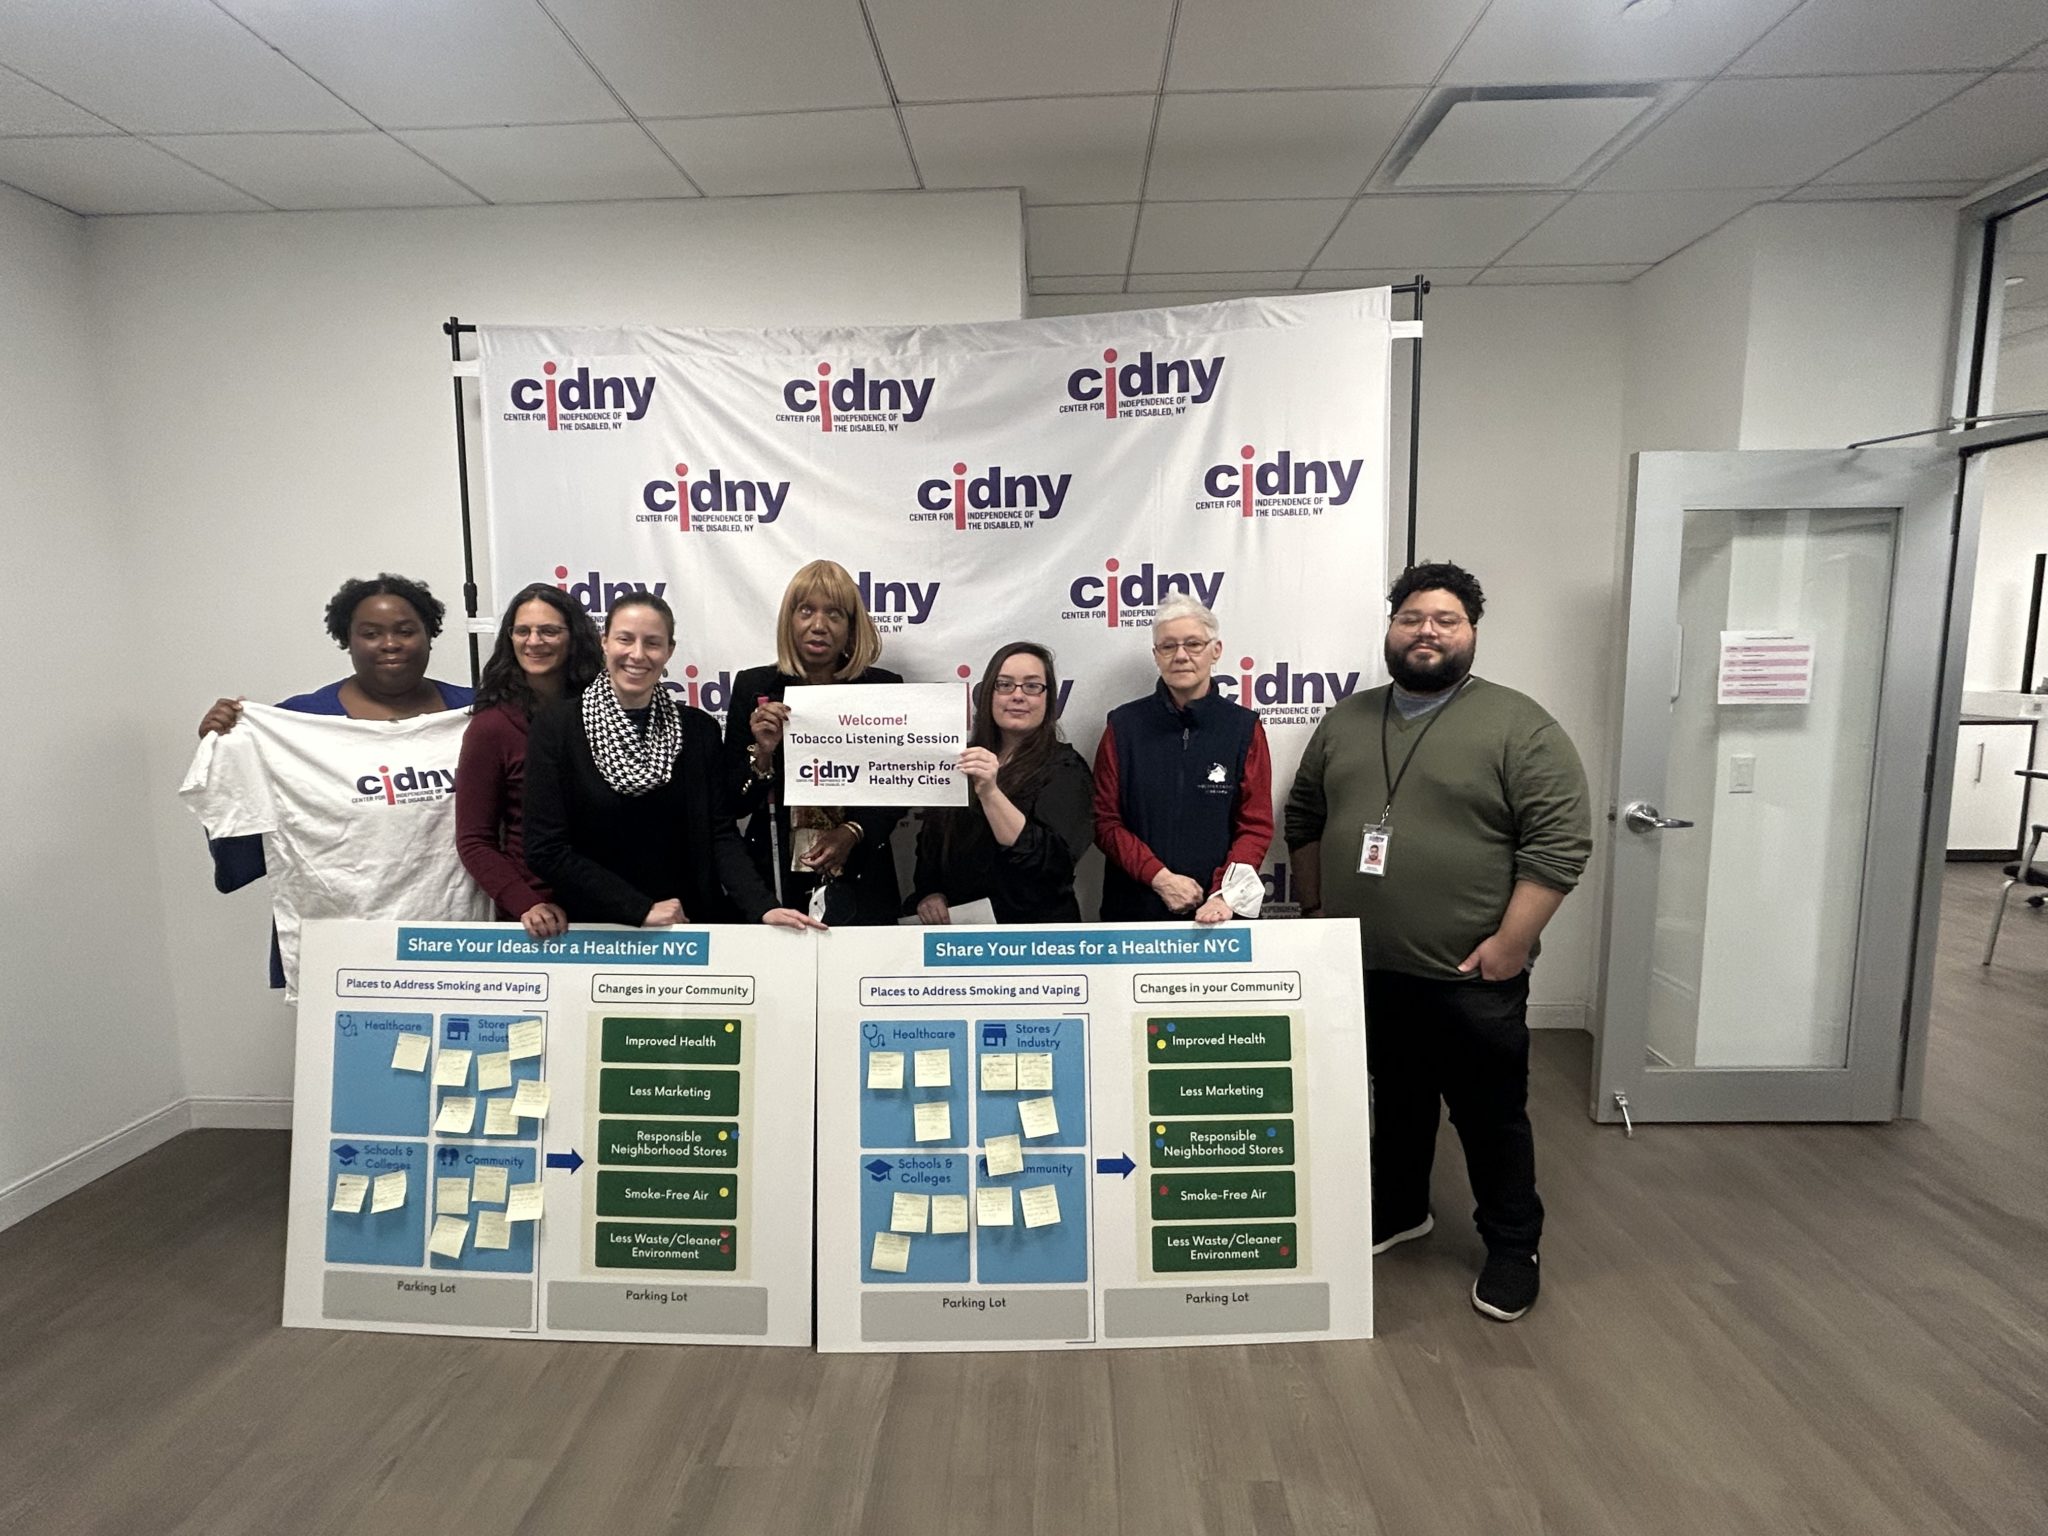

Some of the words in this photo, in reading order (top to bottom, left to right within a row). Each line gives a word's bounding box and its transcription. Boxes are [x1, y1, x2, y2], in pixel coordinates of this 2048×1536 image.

[1068, 348, 1225, 419] cidny
[511, 361, 656, 430] cidny
[784, 362, 935, 432] cidny
[1059, 404, 1088, 413] CENTER
[1090, 403, 1104, 411] FOR
[1119, 398, 1174, 408] INDEPENDENCE
[1177, 396, 1186, 404] OF
[504, 413, 530, 421] CENTER
[776, 414, 804, 422] CENTER
[834, 414, 887, 422] INDEPENDENCE
[1119, 410, 1132, 418] THE
[1135, 408, 1174, 417] DISABLED,
[574, 422, 611, 431] DISABLED,
[850, 424, 887, 432] DISABLED,
[1204, 445, 1364, 517] cidny
[644, 463, 790, 532] cidny
[917, 462, 1072, 530] cidny
[1196, 501, 1224, 510] CENTER
[1255, 498, 1311, 506] INDEPENDENCE
[909, 513, 937, 521] CENTER
[939, 512, 953, 520] FOR
[968, 512, 1022, 520] INDEPENDENCE
[1272, 508, 1311, 516] DISABLED,
[707, 524, 742, 532] DISABLED,
[744, 524, 754, 532] NY
[968, 522, 981, 530] THE
[984, 521, 1022, 530] DISABLED,
[1062, 611, 1089, 619] CENTER
[1092, 610, 1106, 618] FOR
[1120, 609, 1156, 617] INDEPEND
[838, 714, 908, 726] Welcome!
[790, 734, 842, 744] Tobacco
[846, 733, 904, 745] Listening
[907, 733, 959, 744] Session
[800, 758, 860, 786] cidny
[869, 761, 935, 773] Partnership
[939, 761, 956, 771] for
[870, 775, 914, 787] Healthy
[917, 775, 950, 785] Cities
[408, 938, 452, 952] Share
[456, 939, 493, 952] Your
[498, 940, 538, 953] Ideas
[543, 940, 567, 954] for
[570, 944, 579, 954] a
[584, 941, 658, 955] Healthier
[663, 942, 698, 956] NYC
[936, 942, 983, 957] Share
[988, 942, 1027, 956] Your
[1032, 941, 1075, 955] Ideas
[1079, 940, 1103, 955] for
[1108, 944, 1117, 954] a
[1122, 939, 1200, 955] Healthier
[1204, 939, 1240, 953] NYC
[347, 979, 378, 989] Places
[381, 980, 391, 989] to
[394, 980, 435, 990] Address
[437, 982, 481, 993] Smoking
[483, 983, 502, 991] and
[504, 983, 541, 994] Vaping
[598, 984, 643, 995] Changes
[646, 985, 655, 994] in
[659, 986, 683, 996] your
[685, 985, 748, 997] Community
[871, 987, 905, 996] Places
[908, 988, 919, 996] to
[923, 987, 967, 996] Address
[970, 985, 1016, 997] Smoking
[1019, 986, 1039, 994] and
[1042, 984, 1080, 997] Vaping
[1140, 984, 1187, 995] Changes
[1190, 983, 1199, 993] in
[1203, 985, 1227, 994] your
[1231, 982, 1295, 993] Community
[365, 1020, 422, 1031] Healthcare
[478, 1019, 509, 1029] Store
[1016, 1024, 1050, 1033] Stores
[479, 1034, 509, 1042] Indust
[893, 1029, 956, 1040] Healthcare
[1173, 1033, 1225, 1048] Improved
[1228, 1033, 1266, 1044] Health
[626, 1035, 676, 1048] Improved
[680, 1035, 716, 1047] Health
[1017, 1037, 1061, 1049] Industry
[630, 1086, 651, 1096] Less
[655, 1085, 711, 1101] Marketing
[1180, 1086, 1202, 1096] Less
[1206, 1084, 1264, 1098] Marketing
[637, 1131, 701, 1144] Responsible
[1190, 1129, 1257, 1144] Responsible
[365, 1145, 402, 1155] Schools
[611, 1144, 690, 1157] Neighborhood
[693, 1146, 727, 1156] Stores
[1164, 1144, 1246, 1159] Neighborhood
[1249, 1145, 1284, 1154] Stores
[365, 1159, 411, 1170] Colleges
[465, 1154, 524, 1167] Community
[899, 1158, 941, 1169] Schools
[1022, 1165, 1073, 1176] mmunity
[901, 1173, 951, 1186] Colleges
[625, 1188, 689, 1199] Smoke-Free
[693, 1190, 708, 1200] Air
[1180, 1189, 1247, 1201] Smoke-Free
[1251, 1189, 1268, 1199] Air
[610, 1233, 631, 1243] Less
[634, 1233, 721, 1247] Waste/Cleaner
[1167, 1236, 1190, 1246] Less
[1192, 1233, 1282, 1248] Waste/Cleaner
[632, 1247, 699, 1259] Environment
[1190, 1249, 1259, 1260] Environment
[397, 1280, 437, 1295] Parking
[441, 1283, 456, 1293] Lot
[626, 1289, 667, 1304] Parking
[671, 1292, 687, 1301] Lot
[1186, 1291, 1228, 1305] Parking
[1232, 1292, 1249, 1302] Lot
[943, 1296, 985, 1311] Parking
[989, 1297, 1006, 1307] Lot
